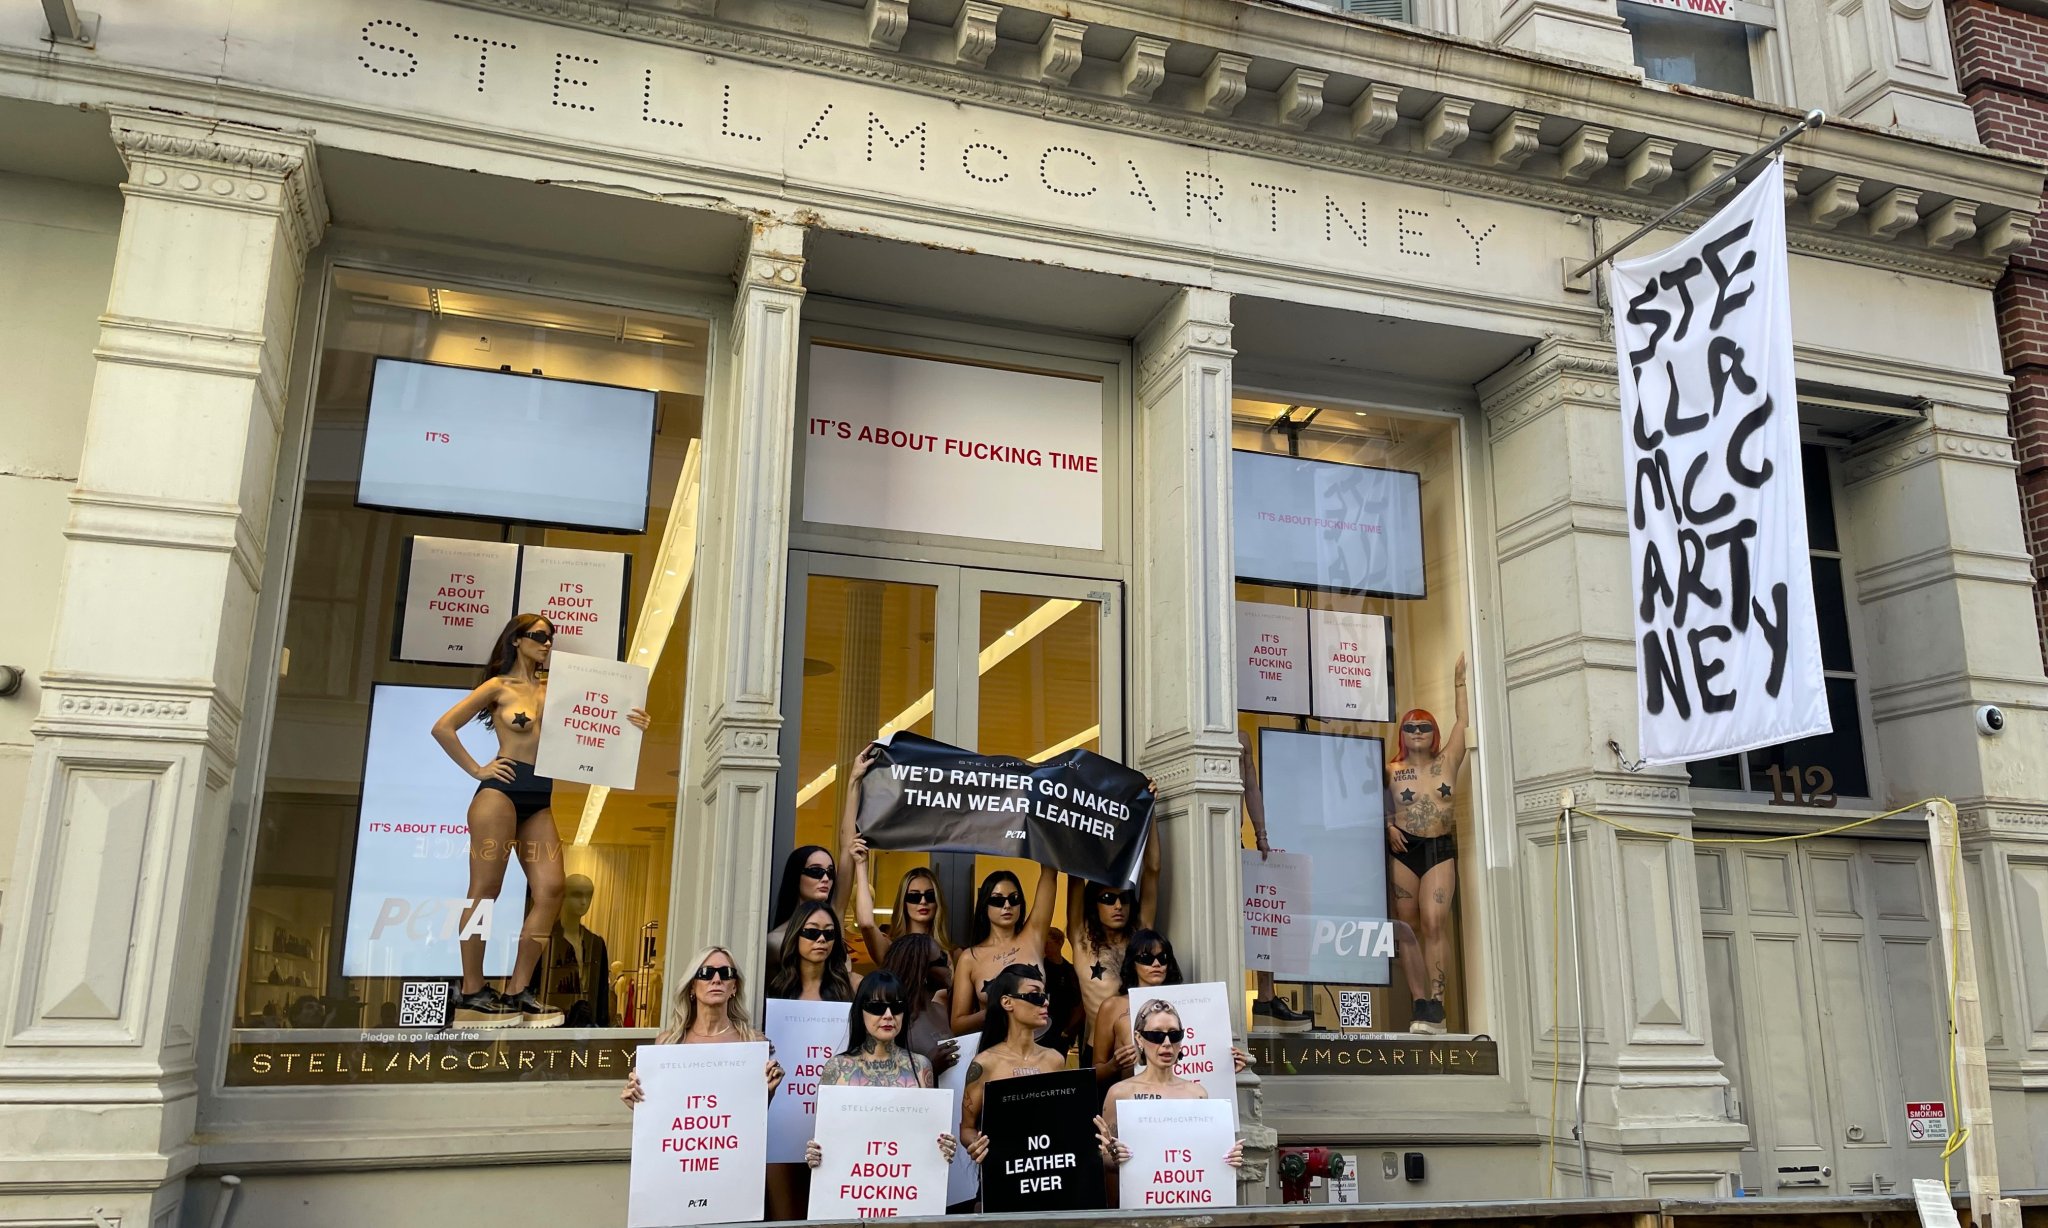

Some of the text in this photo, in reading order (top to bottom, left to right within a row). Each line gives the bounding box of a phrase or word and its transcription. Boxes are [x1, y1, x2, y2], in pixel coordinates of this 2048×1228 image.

[1627, 219, 1757, 366] STE
[425, 431, 450, 444] IT'S
[809, 418, 1098, 473] IT'S ABOUT FUCKING TIME
[1258, 511, 1382, 534] IT'S ABOUT FUCKING TIME
[450, 573, 475, 585] IT'S
[1640, 518, 1757, 633] ART
[437, 587, 485, 600] ABOUT
[559, 583, 583, 594] IT'S
[429, 600, 490, 614] FUCKING
[547, 596, 594, 608] ABOUT
[442, 616, 474, 628] TIME
[540, 609, 598, 623] FUCKING
[554, 624, 583, 636] TIME
[1261, 633, 1280, 644] IT'S
[1253, 645, 1288, 657] ABOUT
[1340, 642, 1358, 651] IT'S
[1643, 582, 1788, 720] NEY
[1249, 657, 1293, 670] FUCKING
[1332, 653, 1366, 664] ABOUT
[1259, 671, 1282, 681] TIME
[1328, 665, 1371, 677] FUCKING
[1339, 678, 1362, 689] TIME
[585, 691, 609, 704] IT'S
[572, 704, 618, 720] ABOUT
[564, 717, 621, 737] FUCKING
[575, 734, 606, 749] TIME
[1393, 774, 1418, 782] VEGAN
[1394, 768, 1415, 776] WEAR
[890, 764, 1130, 821] WE'D RATHER GO NAKED
[1765, 763, 1838, 809] 112
[904, 789, 1115, 841] THAN WEAR LEATHER
[369, 822, 471, 835] IT'S ABOUT FUCK
[1255, 884, 1277, 896] IT'S
[1245, 897, 1286, 910] ABOUT
[1251, 925, 1278, 937] TIME
[360, 1032, 479, 1043] Pledge to go leather free
[1315, 1033, 1339, 1041] Pledge
[1340, 1033, 1348, 1041] to
[1359, 1033, 1383, 1041] leather
[1384, 1033, 1398, 1041] free
[807, 1046, 832, 1058] IT'S
[1180, 1043, 1206, 1057] OUT
[795, 1064, 825, 1076] ABO
[1173, 1061, 1214, 1075] CKING
[686, 1094, 717, 1109] IT'S
[1910, 1110, 1943, 1118] SMOKING
[671, 1115, 731, 1130] ABOUT
[661, 1135, 738, 1152] FUCKING
[866, 1141, 898, 1155] IT'S
[1027, 1134, 1051, 1151] NO
[1164, 1149, 1192, 1163] IT'S
[680, 1157, 720, 1172] TIME
[1005, 1152, 1077, 1175] LEATHER
[850, 1163, 911, 1178] ABOUT
[1153, 1169, 1205, 1184] ABOUT
[1020, 1175, 1062, 1194] EVER
[840, 1185, 918, 1200] FUCKING
[1145, 1189, 1212, 1205] FUCKING
[857, 1207, 898, 1218] TIME
